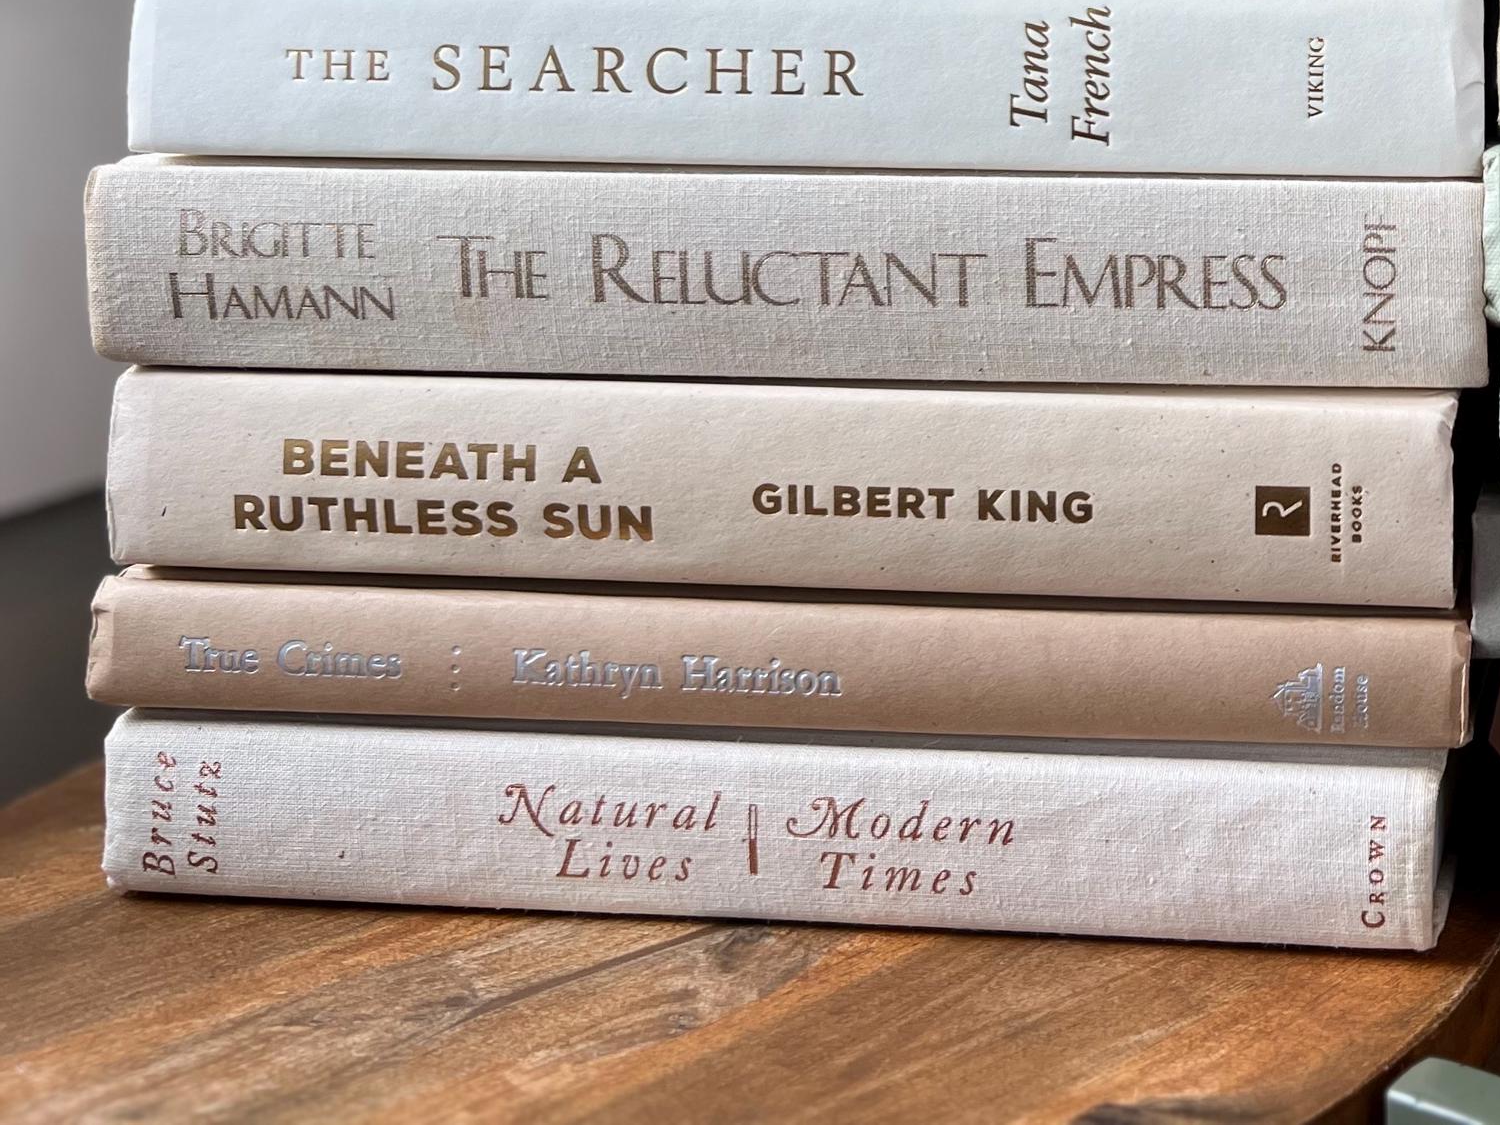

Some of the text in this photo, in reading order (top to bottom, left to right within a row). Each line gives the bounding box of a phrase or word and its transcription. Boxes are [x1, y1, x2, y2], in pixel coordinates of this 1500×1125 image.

[284, 43, 865, 98] THE SEARCHER
[1009, 19, 1052, 128] Tana
[1071, 4, 1113, 148] French
[1306, 35, 1326, 119] VIKING
[168, 271, 396, 322] HAMANN
[436, 233, 548, 301] THE
[1025, 237, 1289, 311] EMPRESS
[1362, 213, 1398, 353] KNOPF
[282, 437, 602, 485] BENEATH A
[233, 493, 654, 543] RUTHLESS SUN
[752, 482, 1095, 525] GILBERT KING
[1330, 462, 1343, 564] RIVERHEAD
[1351, 484, 1364, 544] BOOKS
[180, 636, 402, 679] True Crimes
[513, 648, 843, 701] Kathryn Harrison
[142, 751, 179, 878] Bruce
[188, 760, 223, 874] Stutz
[498, 782, 723, 838] Natural
[785, 795, 1016, 848] Modern
[556, 837, 693, 882] Lives
[820, 851, 979, 898] Times
